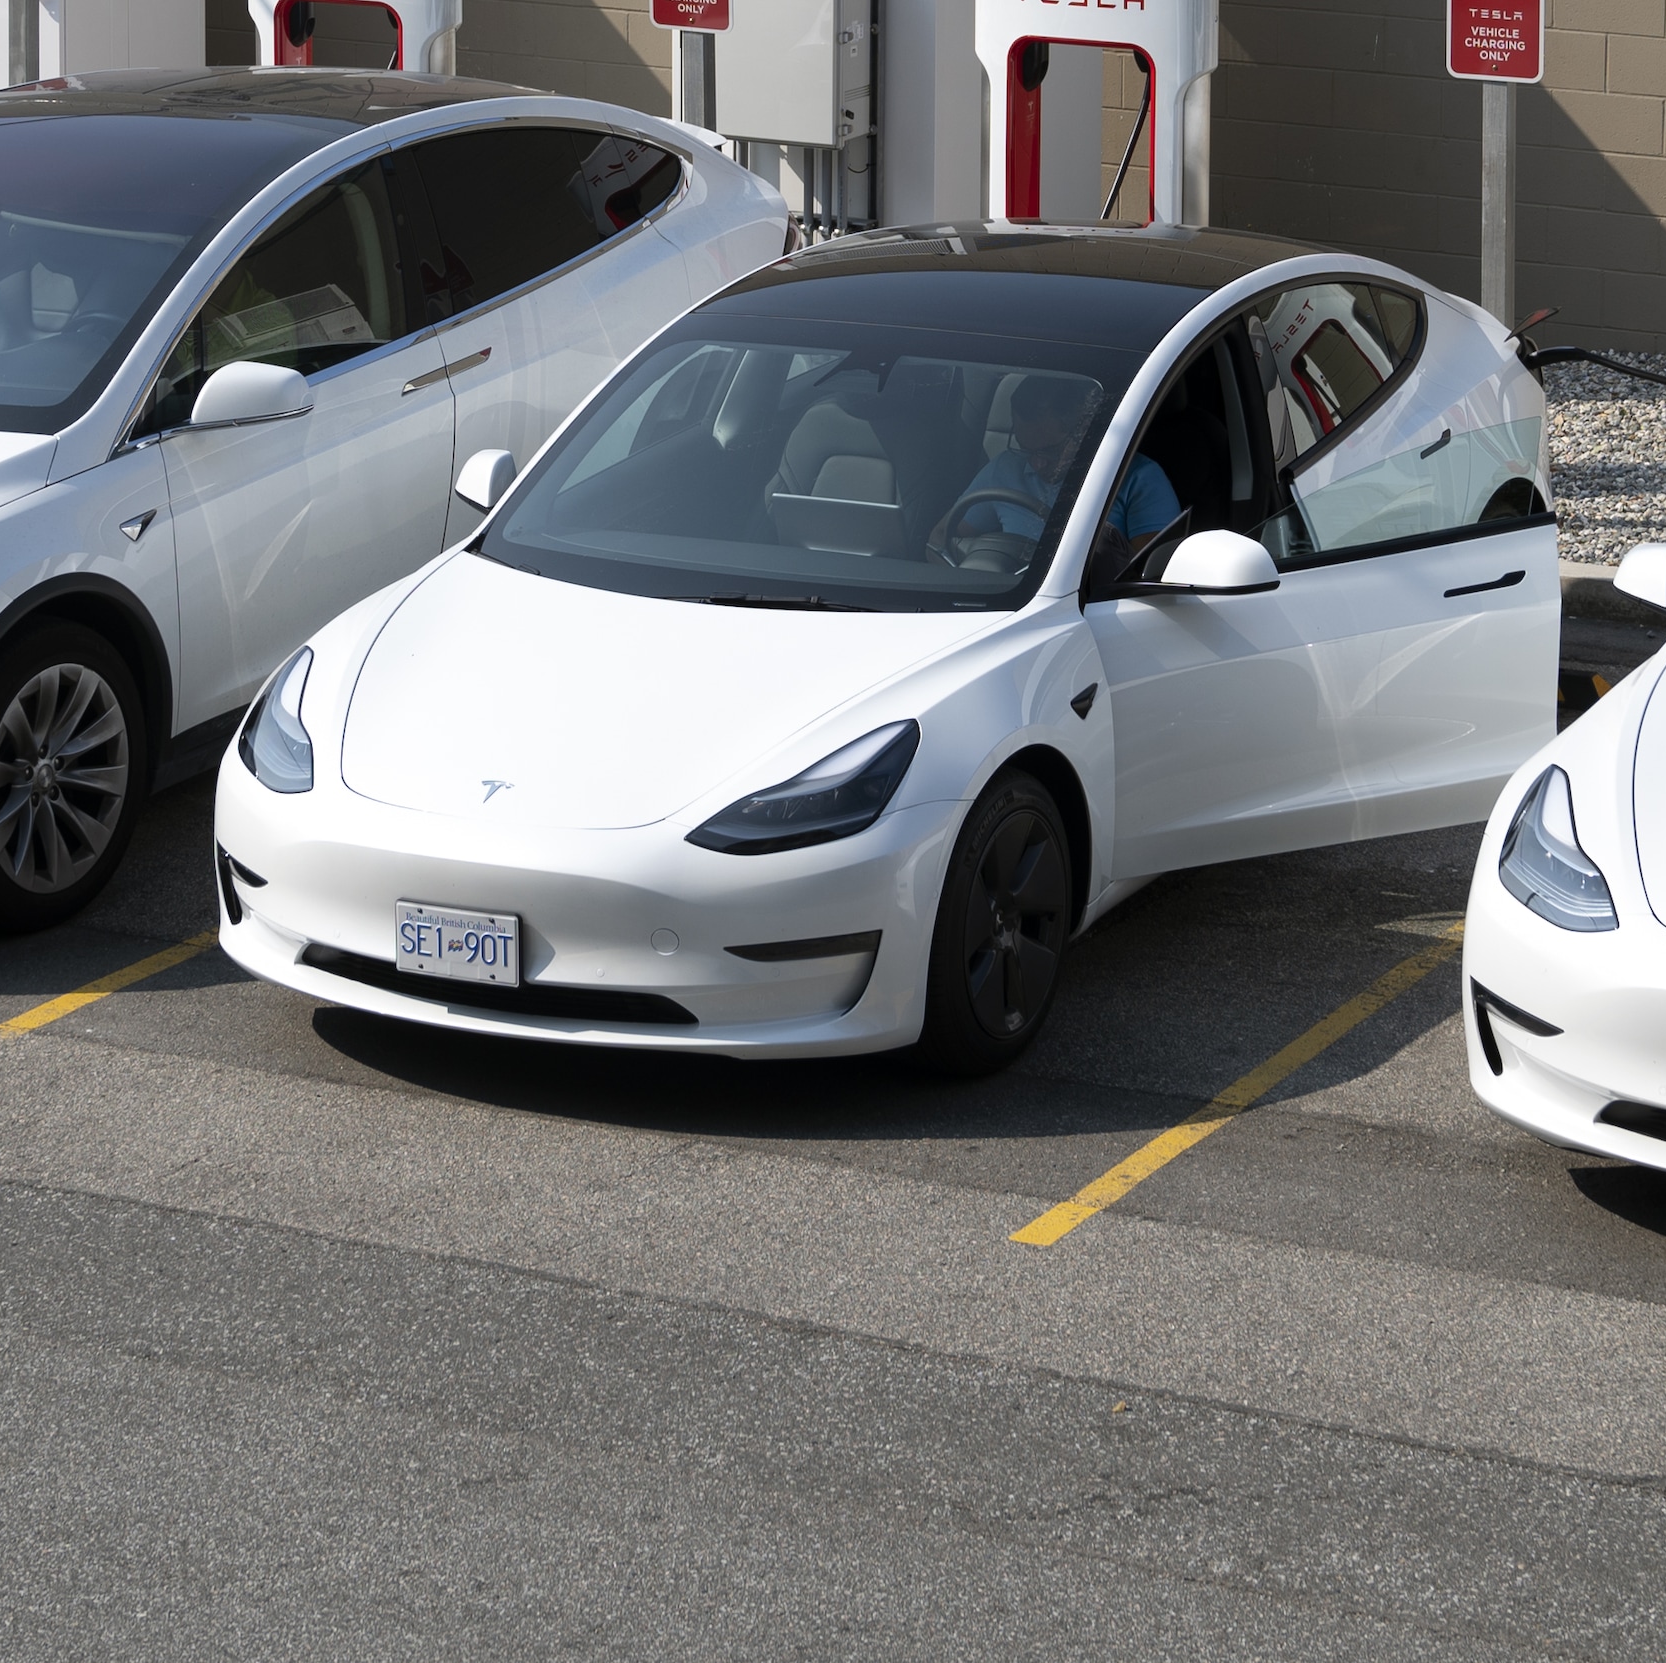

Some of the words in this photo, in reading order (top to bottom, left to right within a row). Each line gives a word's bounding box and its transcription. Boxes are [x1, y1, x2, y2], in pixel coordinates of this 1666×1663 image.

[677, 3, 705, 14] ONLY
[1469, 8, 1523, 21] TESLA
[1470, 26, 1520, 39] VEHICLE
[1464, 37, 1526, 51] CHARGING
[1479, 50, 1510, 62] ONLY
[406, 912, 439, 925] Beautiful
[441, 917, 466, 929] British
[467, 921, 506, 933] Columbia
[400, 920, 442, 958] SE1
[464, 930, 513, 967] 90T
